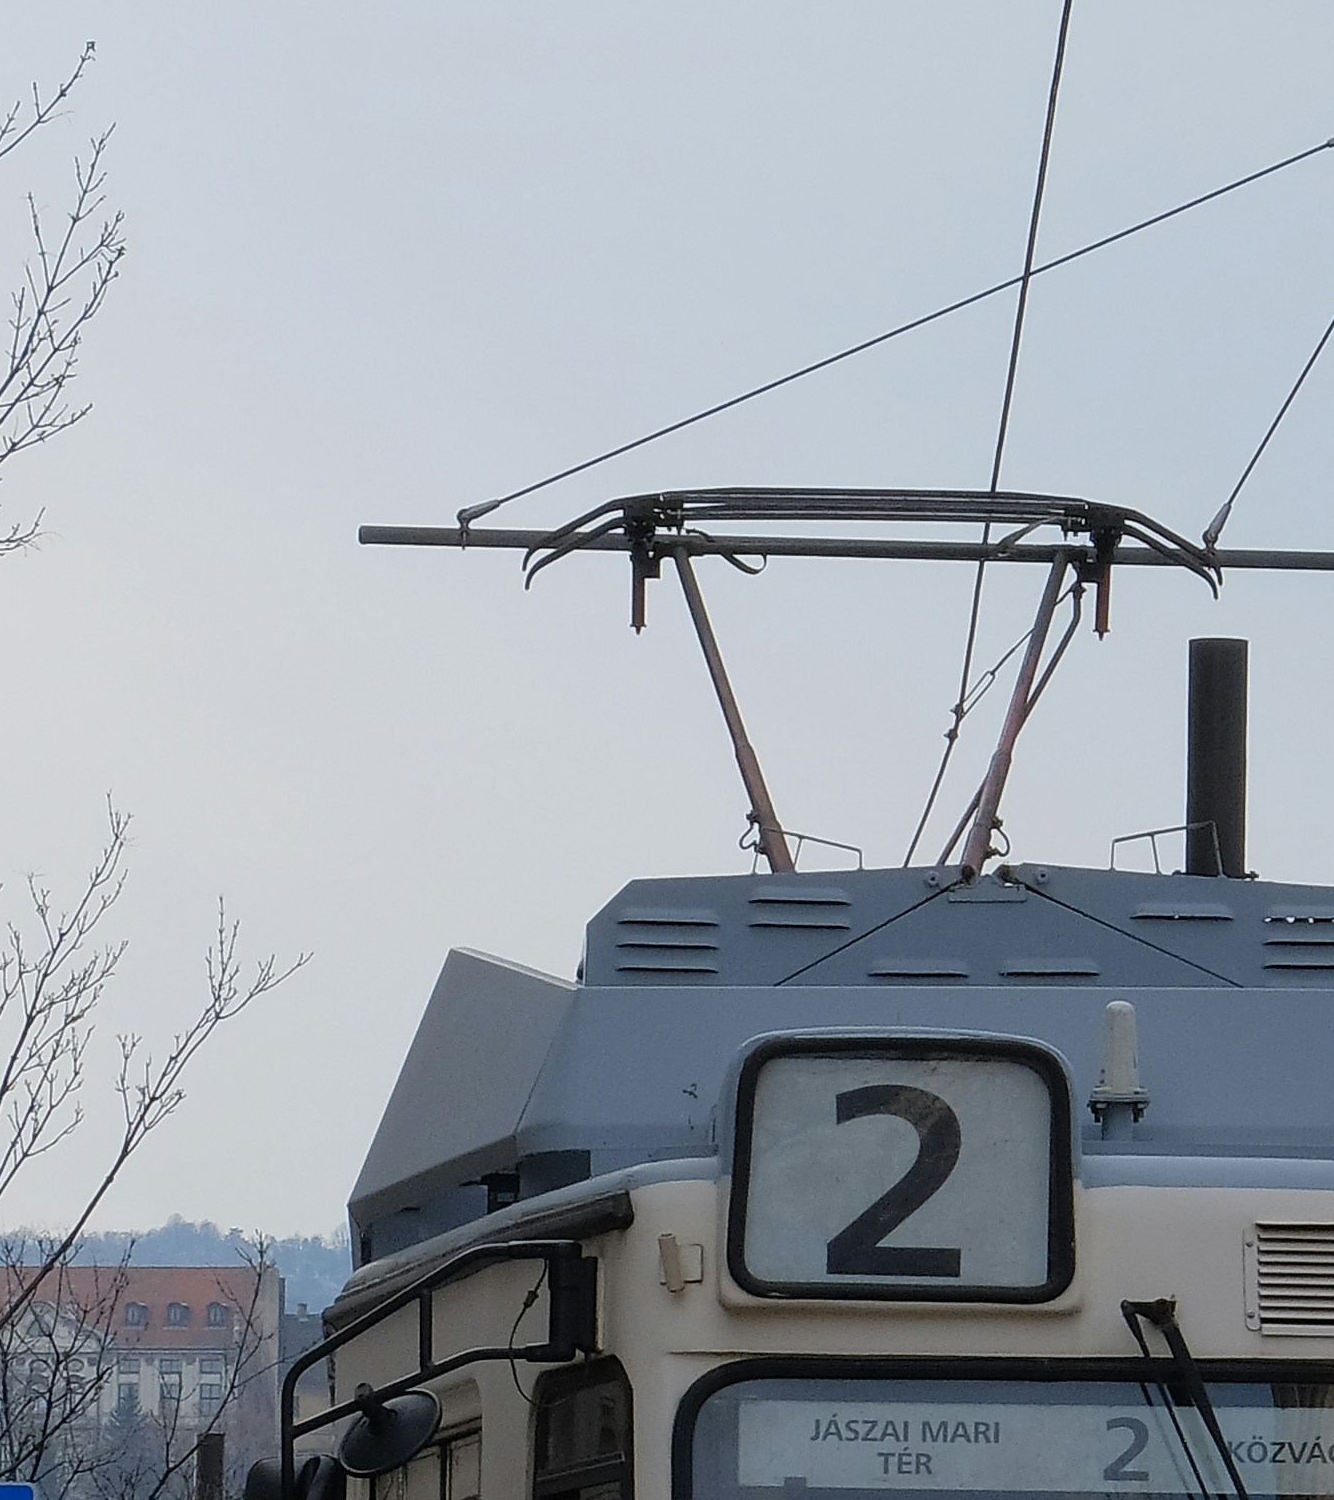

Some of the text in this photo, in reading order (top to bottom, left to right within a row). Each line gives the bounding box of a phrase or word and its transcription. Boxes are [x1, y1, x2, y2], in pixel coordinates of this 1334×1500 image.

[824, 1083, 963, 1278] 2
[809, 1413, 1002, 1444] JÁSZAI MARI
[1102, 1416, 1151, 1482] 2
[876, 1447, 933, 1476] TÉR
